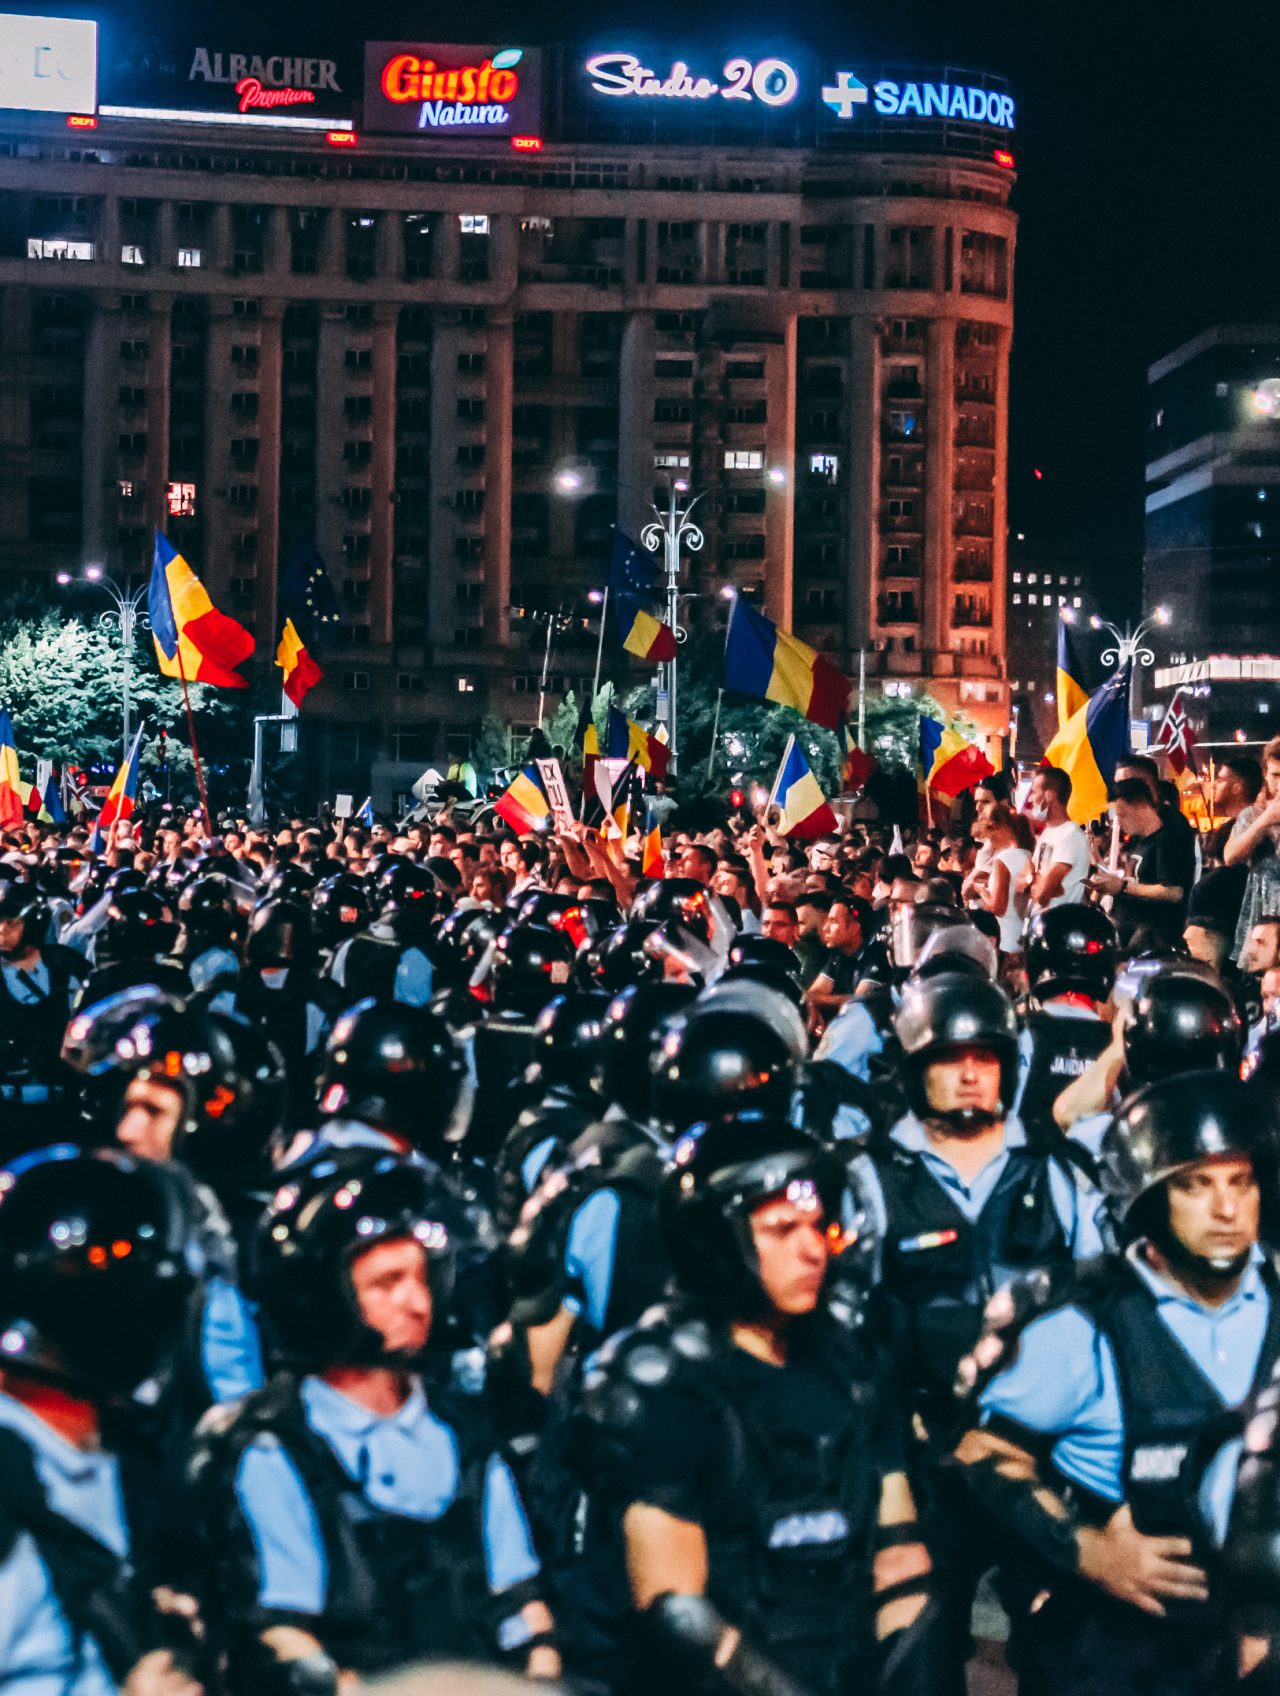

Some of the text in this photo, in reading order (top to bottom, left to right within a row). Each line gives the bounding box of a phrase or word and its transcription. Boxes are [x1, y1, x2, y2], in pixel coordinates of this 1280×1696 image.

[188, 48, 343, 92] ALBACHER
[382, 54, 518, 103] Giusto
[586, 53, 798, 105] Studio 20
[235, 77, 315, 112] Premium
[419, 100, 509, 128] Natura
[874, 81, 1015, 129] SANADOR
